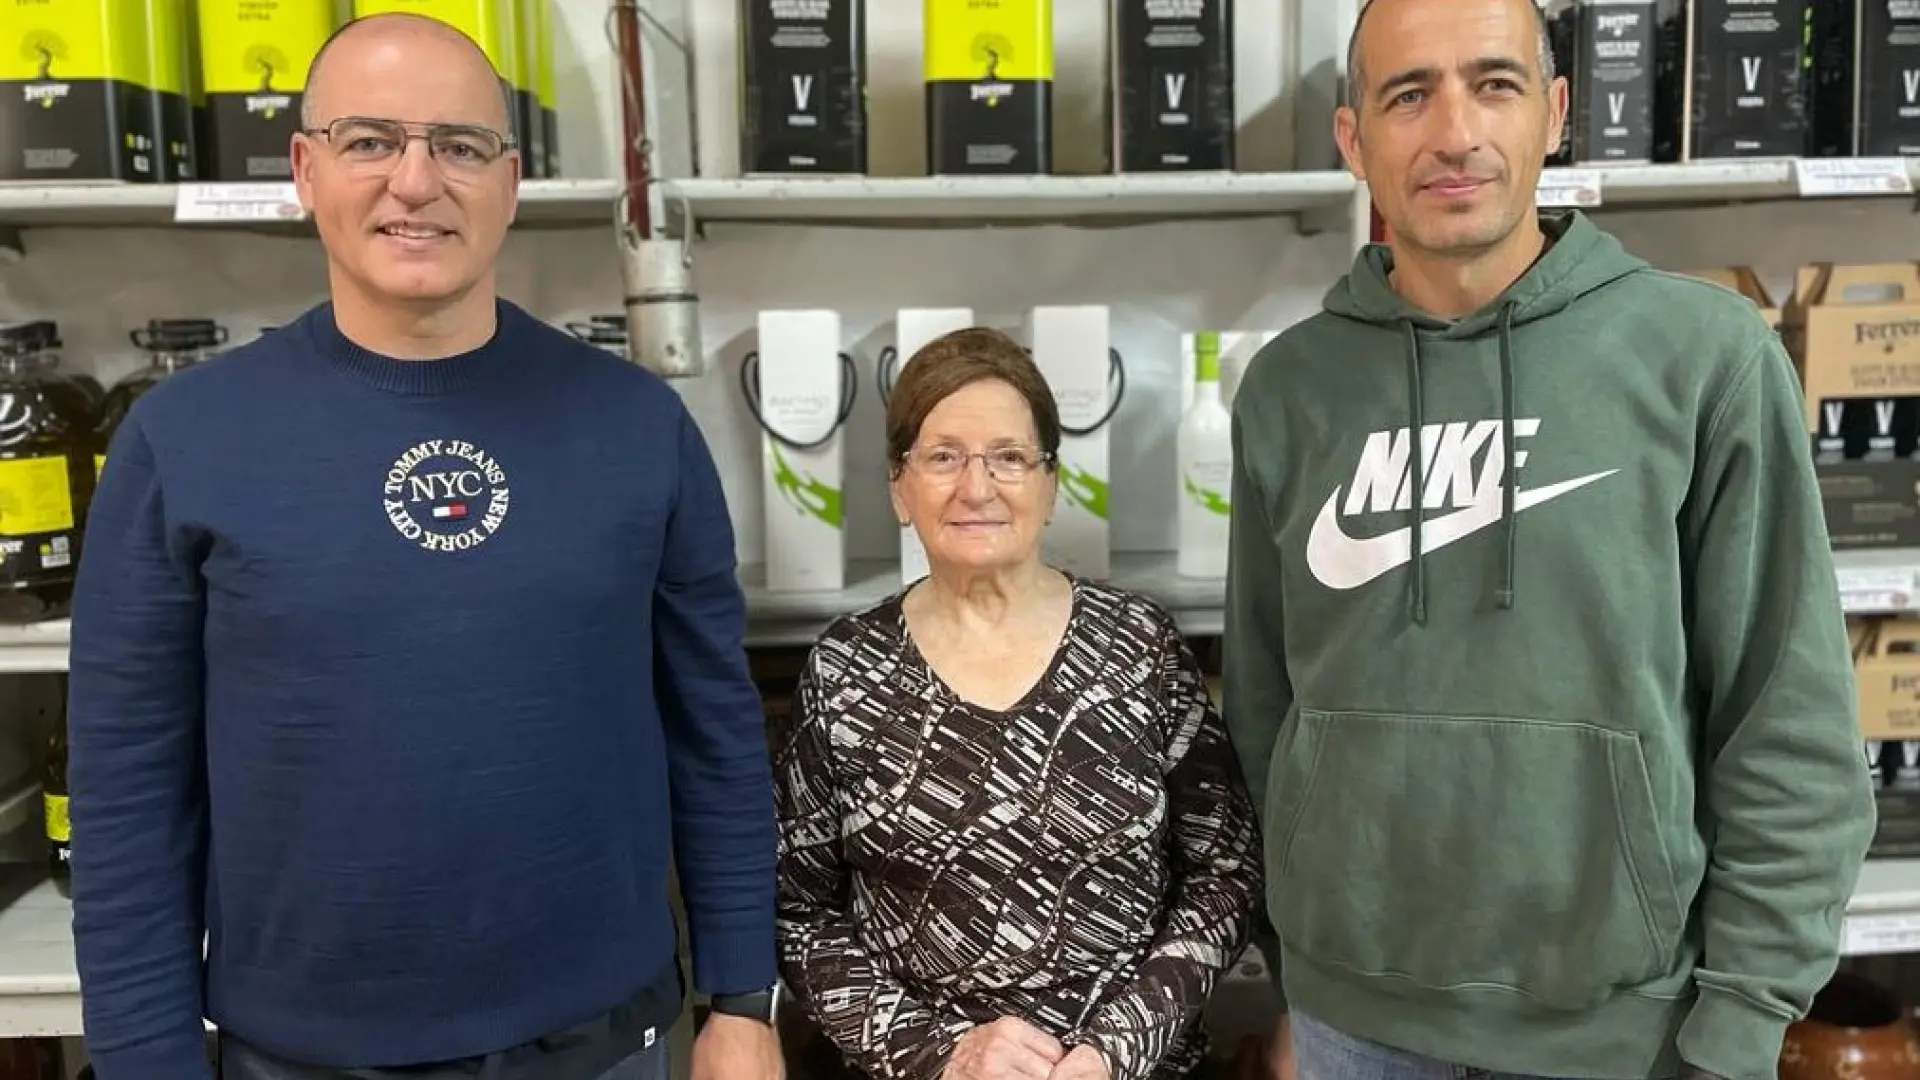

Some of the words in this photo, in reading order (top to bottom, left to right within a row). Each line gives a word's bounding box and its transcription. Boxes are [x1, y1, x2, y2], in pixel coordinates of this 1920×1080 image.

[792, 74, 812, 111] V
[1165, 73, 1186, 109] V
[1741, 57, 1761, 92] V
[1608, 92, 1625, 125] V
[1825, 401, 1844, 436] V
[1875, 401, 1895, 436] V
[384, 439, 443, 495] TOMMY
[445, 440, 506, 485] JEANS
[1342, 418, 1542, 516] NIKE
[408, 470, 483, 502] NYC
[384, 498, 422, 540] CITY
[481, 487, 510, 535] NEW
[420, 527, 487, 552] YORK
